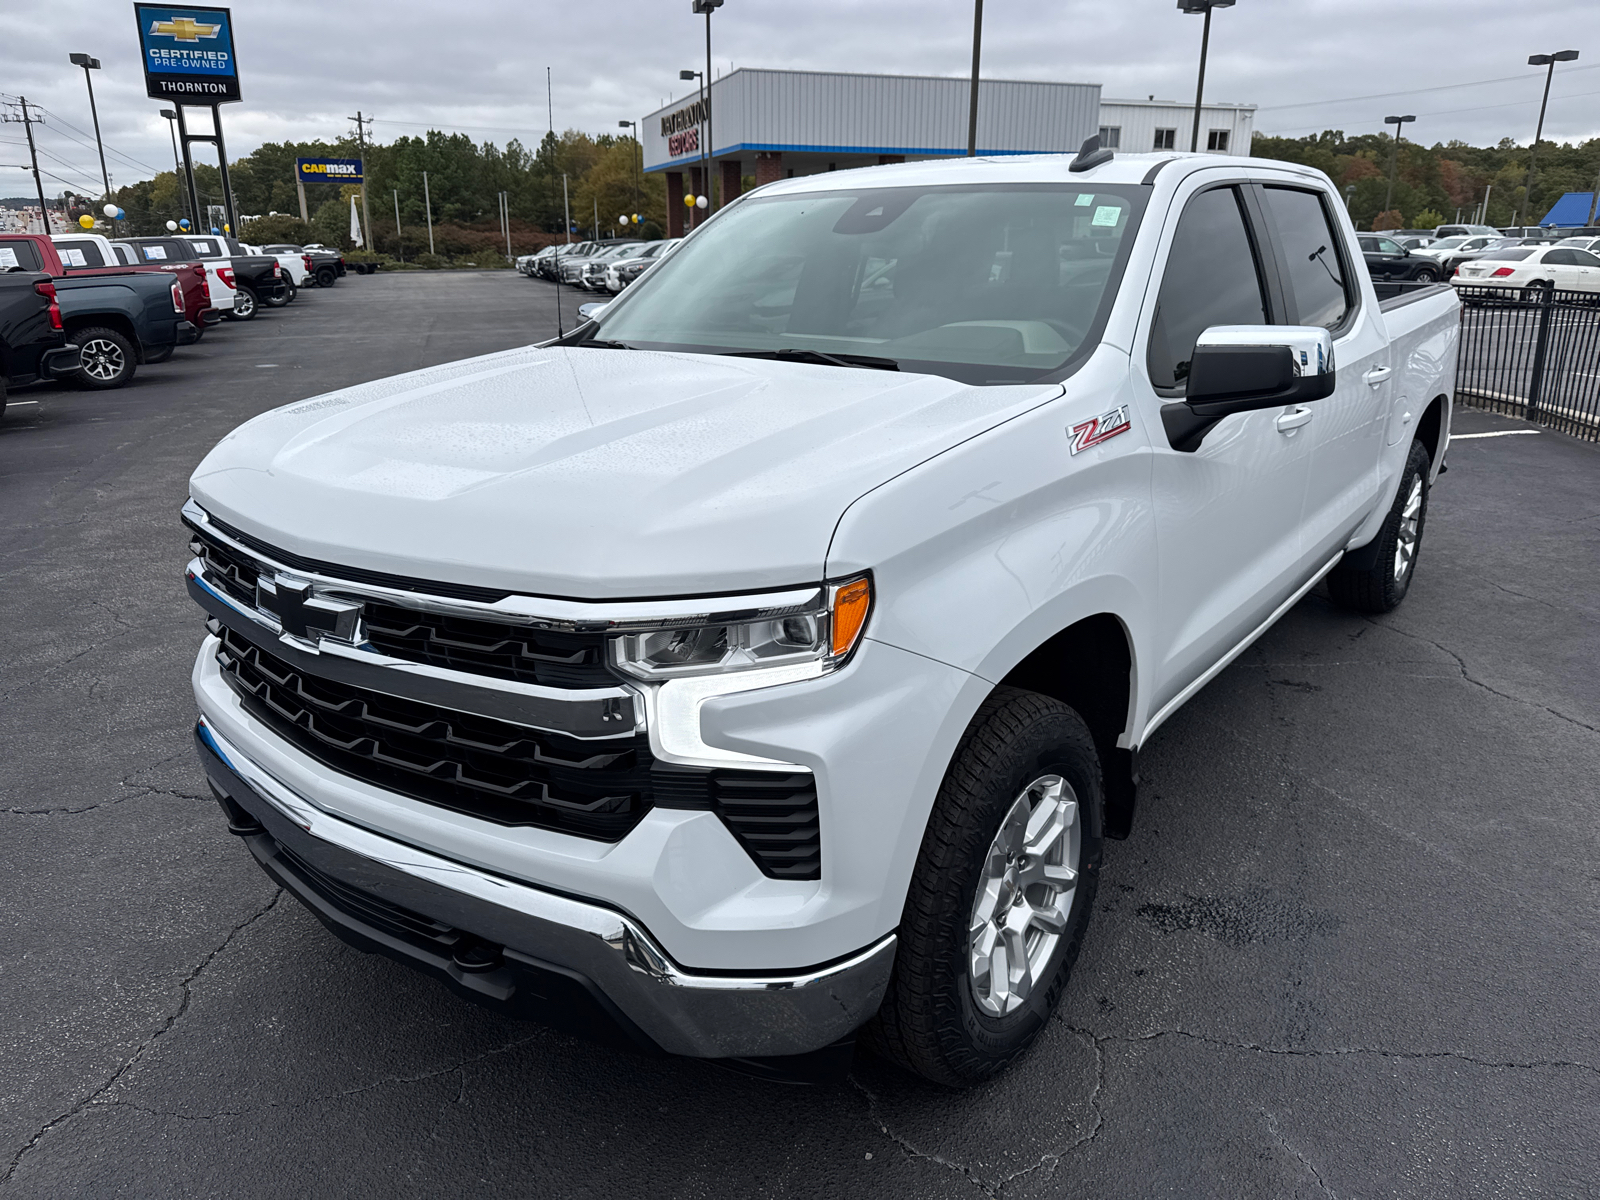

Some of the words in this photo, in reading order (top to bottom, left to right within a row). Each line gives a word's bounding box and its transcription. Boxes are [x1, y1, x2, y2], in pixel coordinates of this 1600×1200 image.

[149, 49, 228, 60] CERTIFIED
[155, 58, 225, 69] PRE-OWNED
[160, 81, 227, 94] THORNTON
[668, 134, 683, 156] USED
[682, 128, 699, 153] CARS
[302, 163, 356, 174] CARmax
[1065, 404, 1131, 456] Z71
